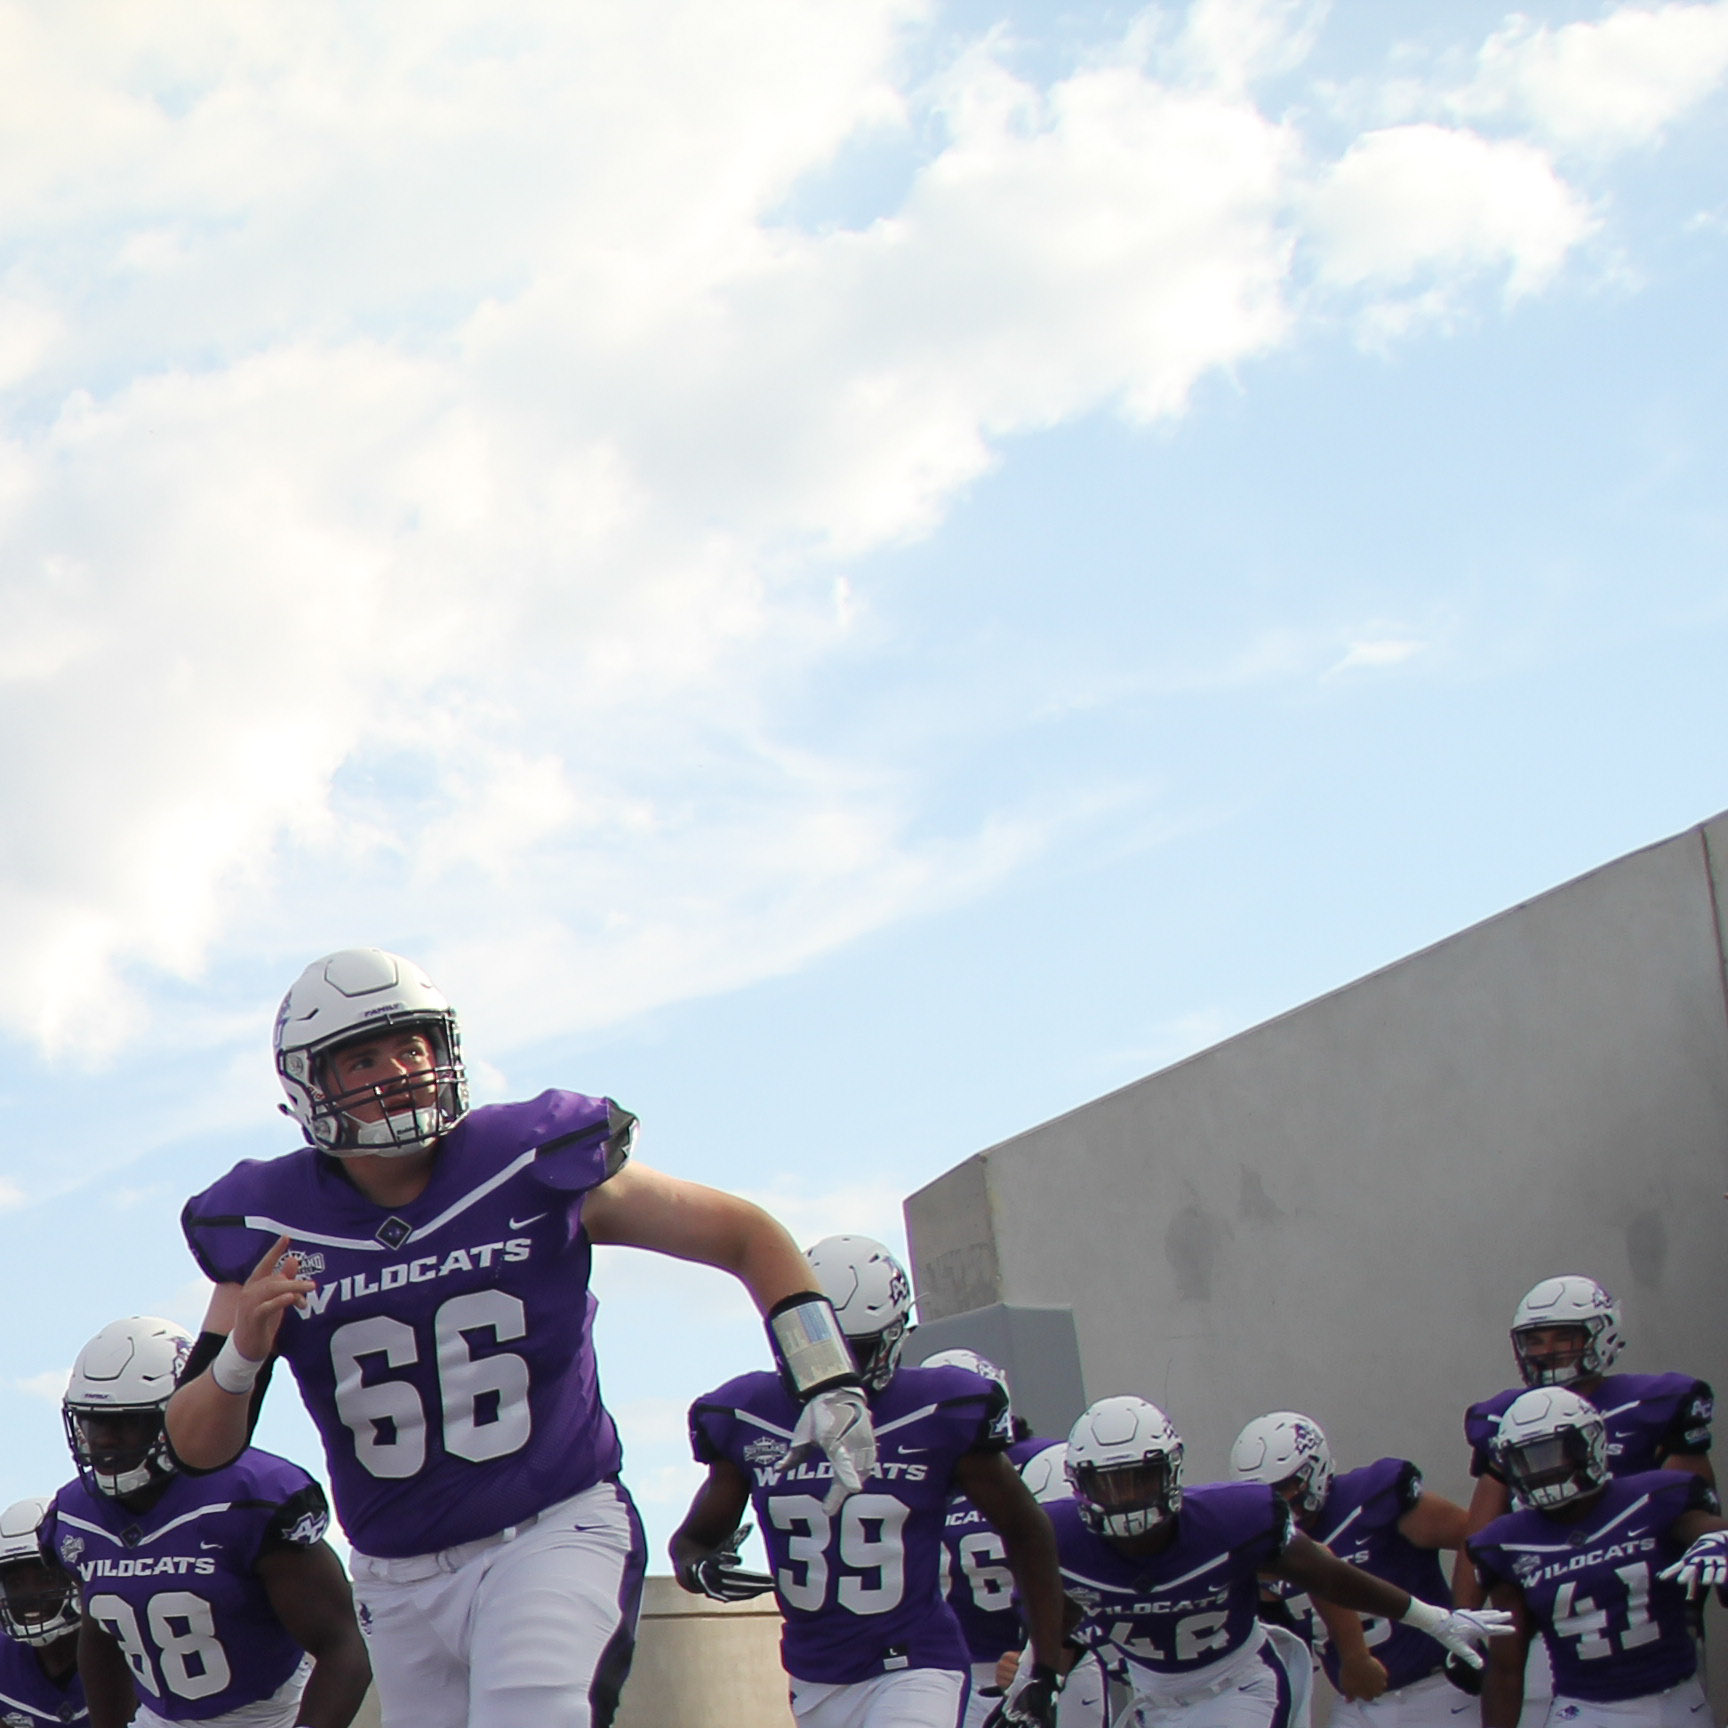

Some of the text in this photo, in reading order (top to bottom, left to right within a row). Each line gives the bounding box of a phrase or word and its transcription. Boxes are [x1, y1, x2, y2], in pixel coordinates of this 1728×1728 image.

[294, 1238, 532, 1320] WILDCATS
[330, 1288, 532, 1478] 66
[754, 1461, 928, 1488] WILDATS
[77, 1556, 216, 1583] WILDCATS
[767, 1493, 911, 1616] 39
[939, 1532, 1015, 1612] 6
[1521, 1538, 1657, 1589] WILDCATS
[1552, 1560, 1661, 1661] 41
